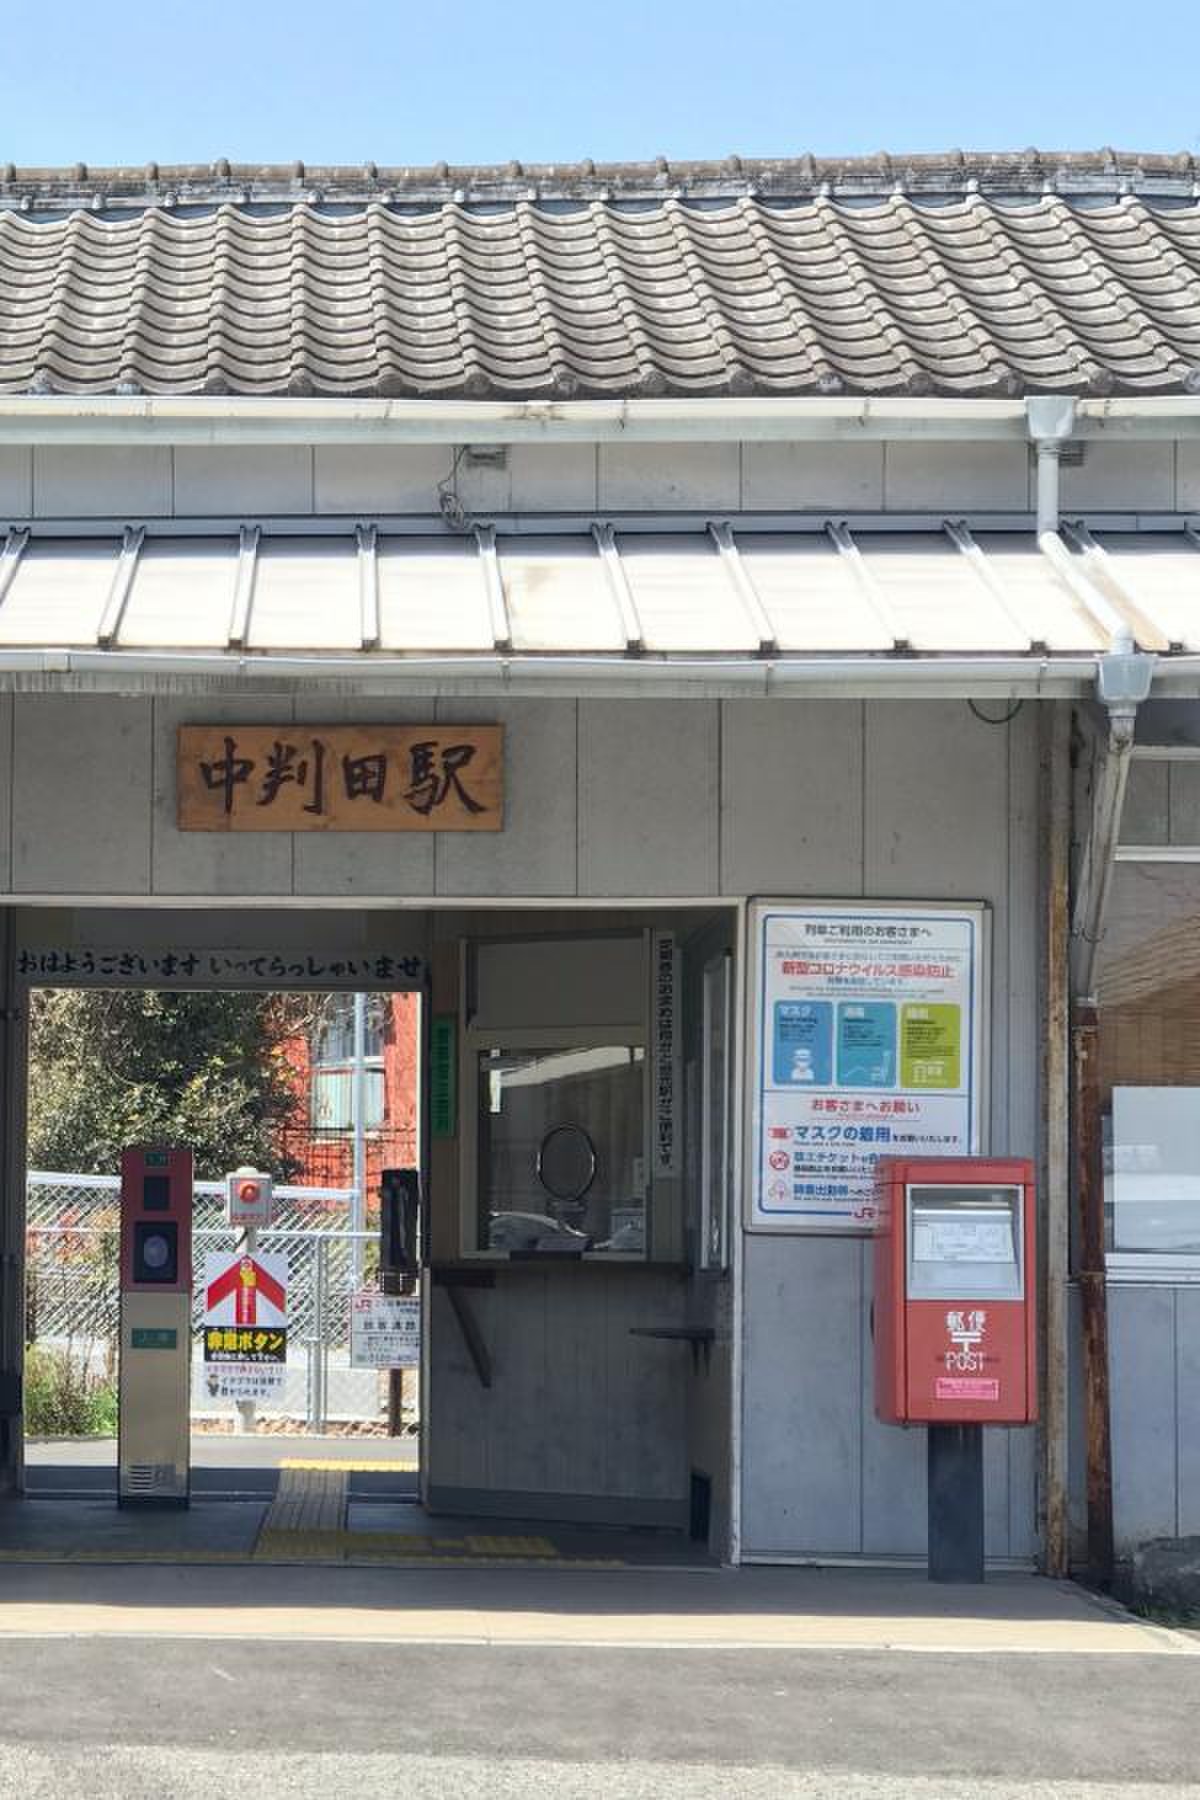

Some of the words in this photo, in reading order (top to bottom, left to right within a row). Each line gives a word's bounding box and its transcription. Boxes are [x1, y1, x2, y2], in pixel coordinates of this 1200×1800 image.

[199, 735, 487, 815] 中判田駅
[17, 950, 200, 977] おはようございます
[209, 953, 422, 978] いってらっしゃいませ
[946, 1351, 984, 1371] POST
